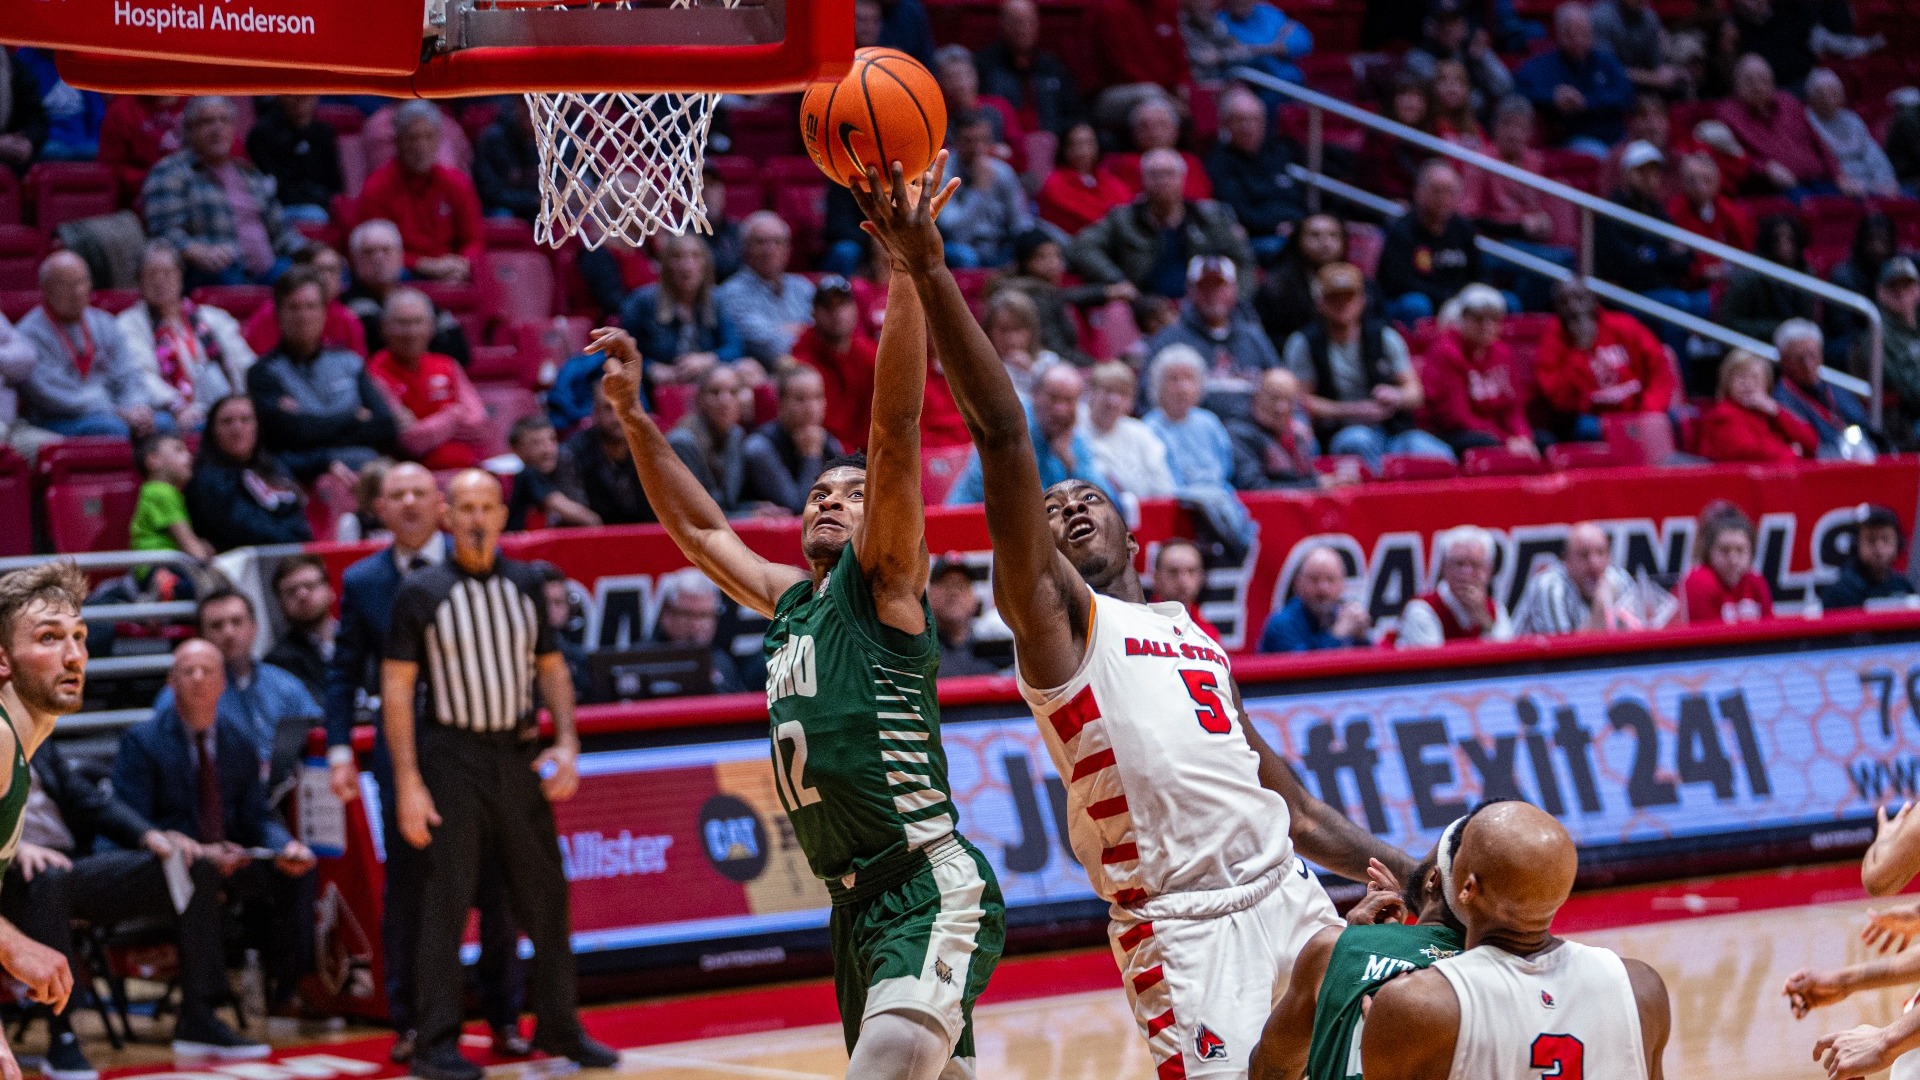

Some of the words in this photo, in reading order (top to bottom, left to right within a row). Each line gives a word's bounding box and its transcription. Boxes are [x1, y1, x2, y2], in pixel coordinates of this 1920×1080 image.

[114, 1, 205, 33] Hospital
[210, 6, 315, 34] Anderson
[1125, 637, 1180, 658] BALL
[1179, 642, 1231, 673] STAT
[1178, 669, 1232, 734] 5
[773, 720, 822, 811] 12
[1394, 697, 1604, 829] Exit
[1607, 687, 1773, 809] 241
[704, 816, 759, 861] CAT
[1361, 954, 1416, 981] MIT
